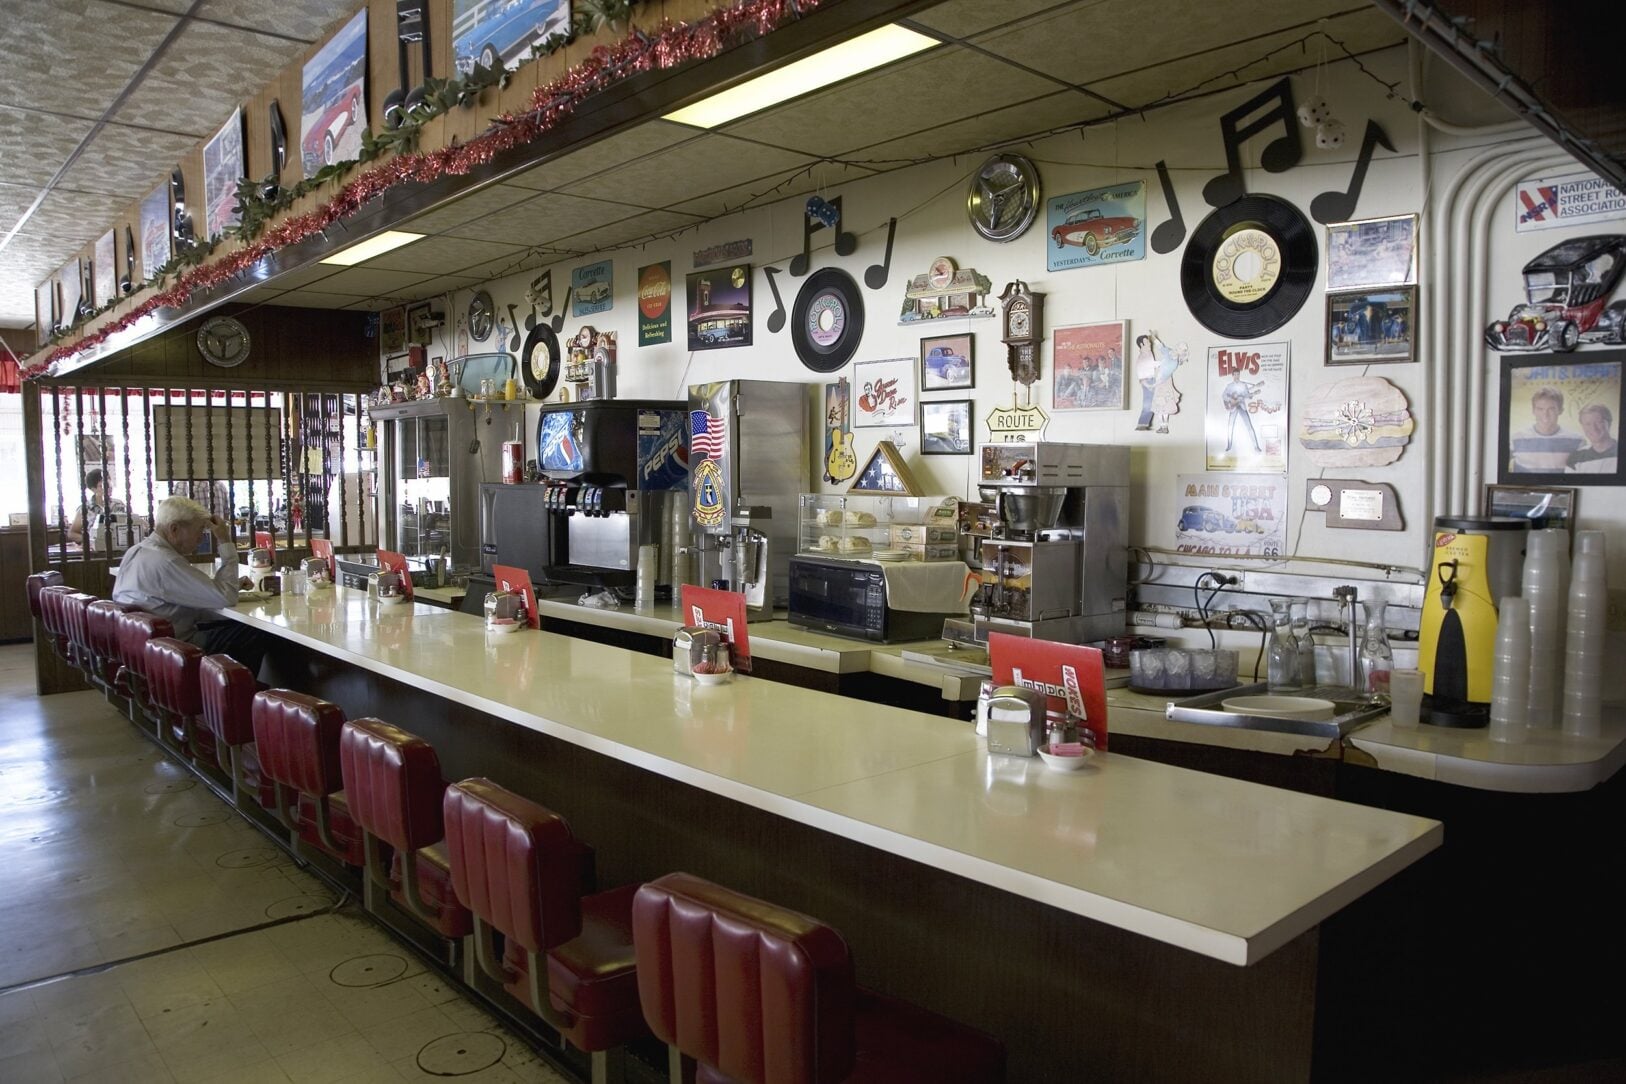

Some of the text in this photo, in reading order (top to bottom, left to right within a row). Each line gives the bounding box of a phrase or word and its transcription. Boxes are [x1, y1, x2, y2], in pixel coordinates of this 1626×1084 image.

[1560, 180, 1611, 195] NATIONA
[1560, 188, 1622, 206] STREET RO
[1560, 199, 1626, 217] ASSOCIATIO
[1100, 248, 1136, 260] Corvette
[1218, 350, 1261, 377] ELVIS
[997, 414, 1034, 428] ROUTE
[644, 429, 682, 480] PEPSI
[1185, 484, 1276, 499] MAIN STREET
[1231, 497, 1274, 520] USA
[1177, 544, 1216, 555] CHICAGO
[1264, 547, 1279, 561] 66
